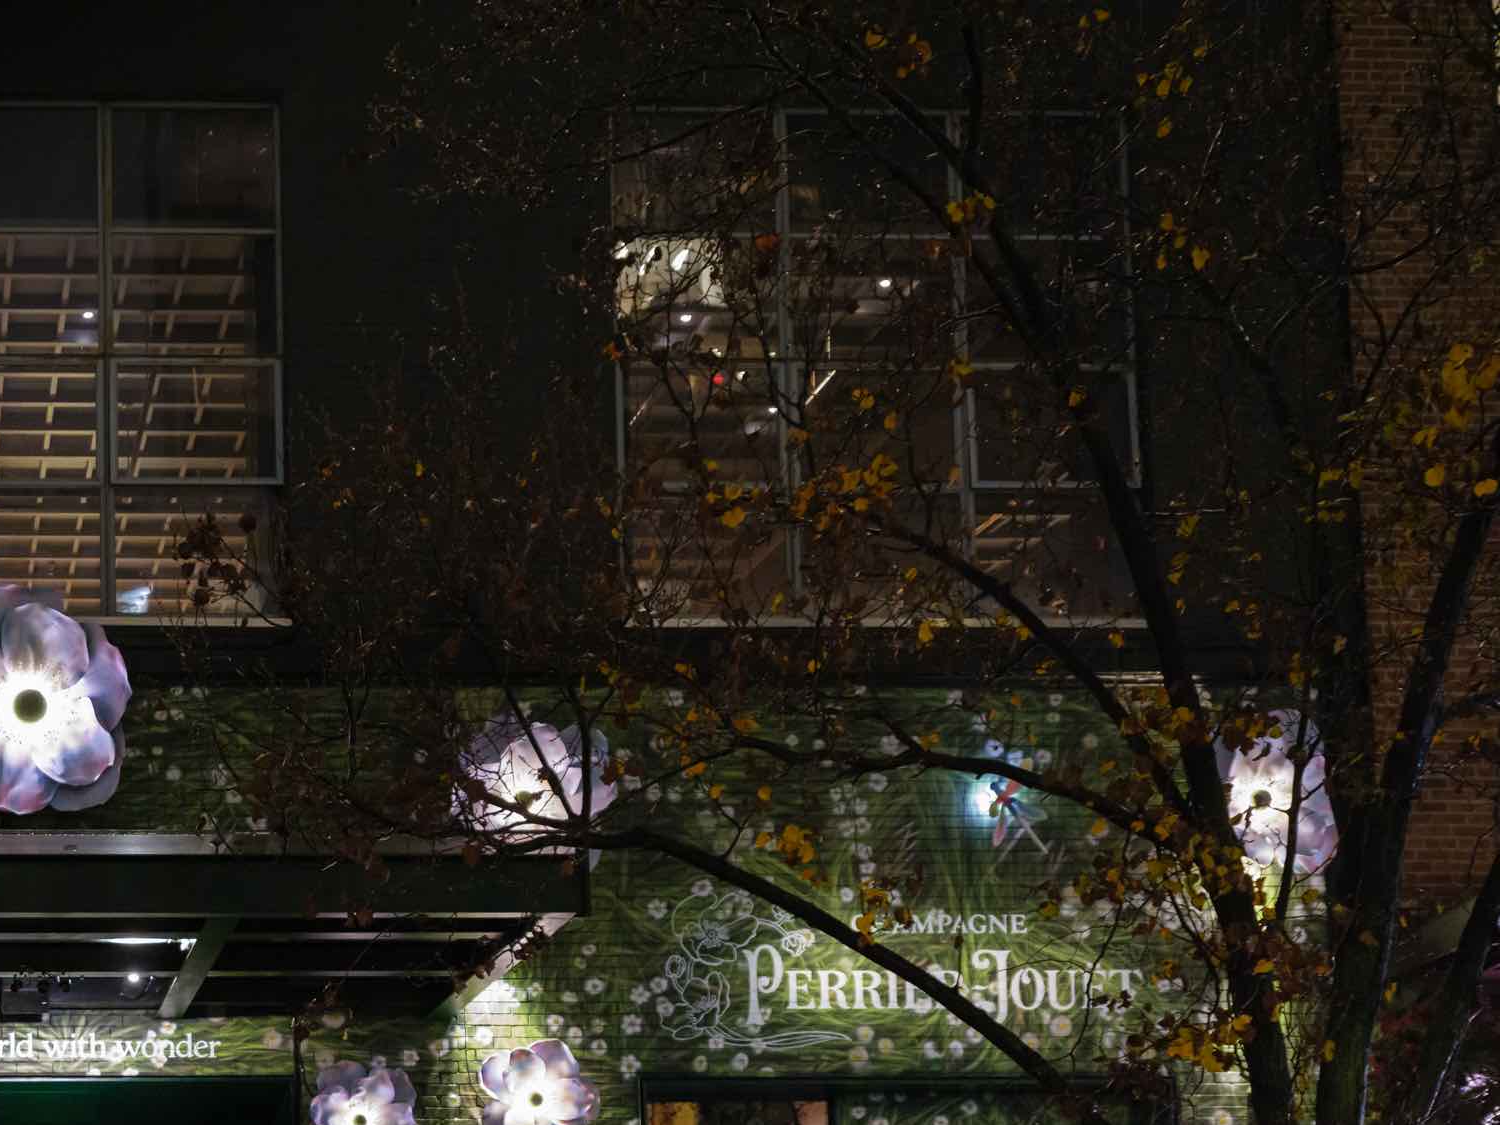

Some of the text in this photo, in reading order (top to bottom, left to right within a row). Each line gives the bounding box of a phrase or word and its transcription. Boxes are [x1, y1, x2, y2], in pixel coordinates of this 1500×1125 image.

[851, 913, 1028, 935] CAMPAGNE
[43, 1032, 105, 1058] with
[115, 1032, 222, 1058] wonder
